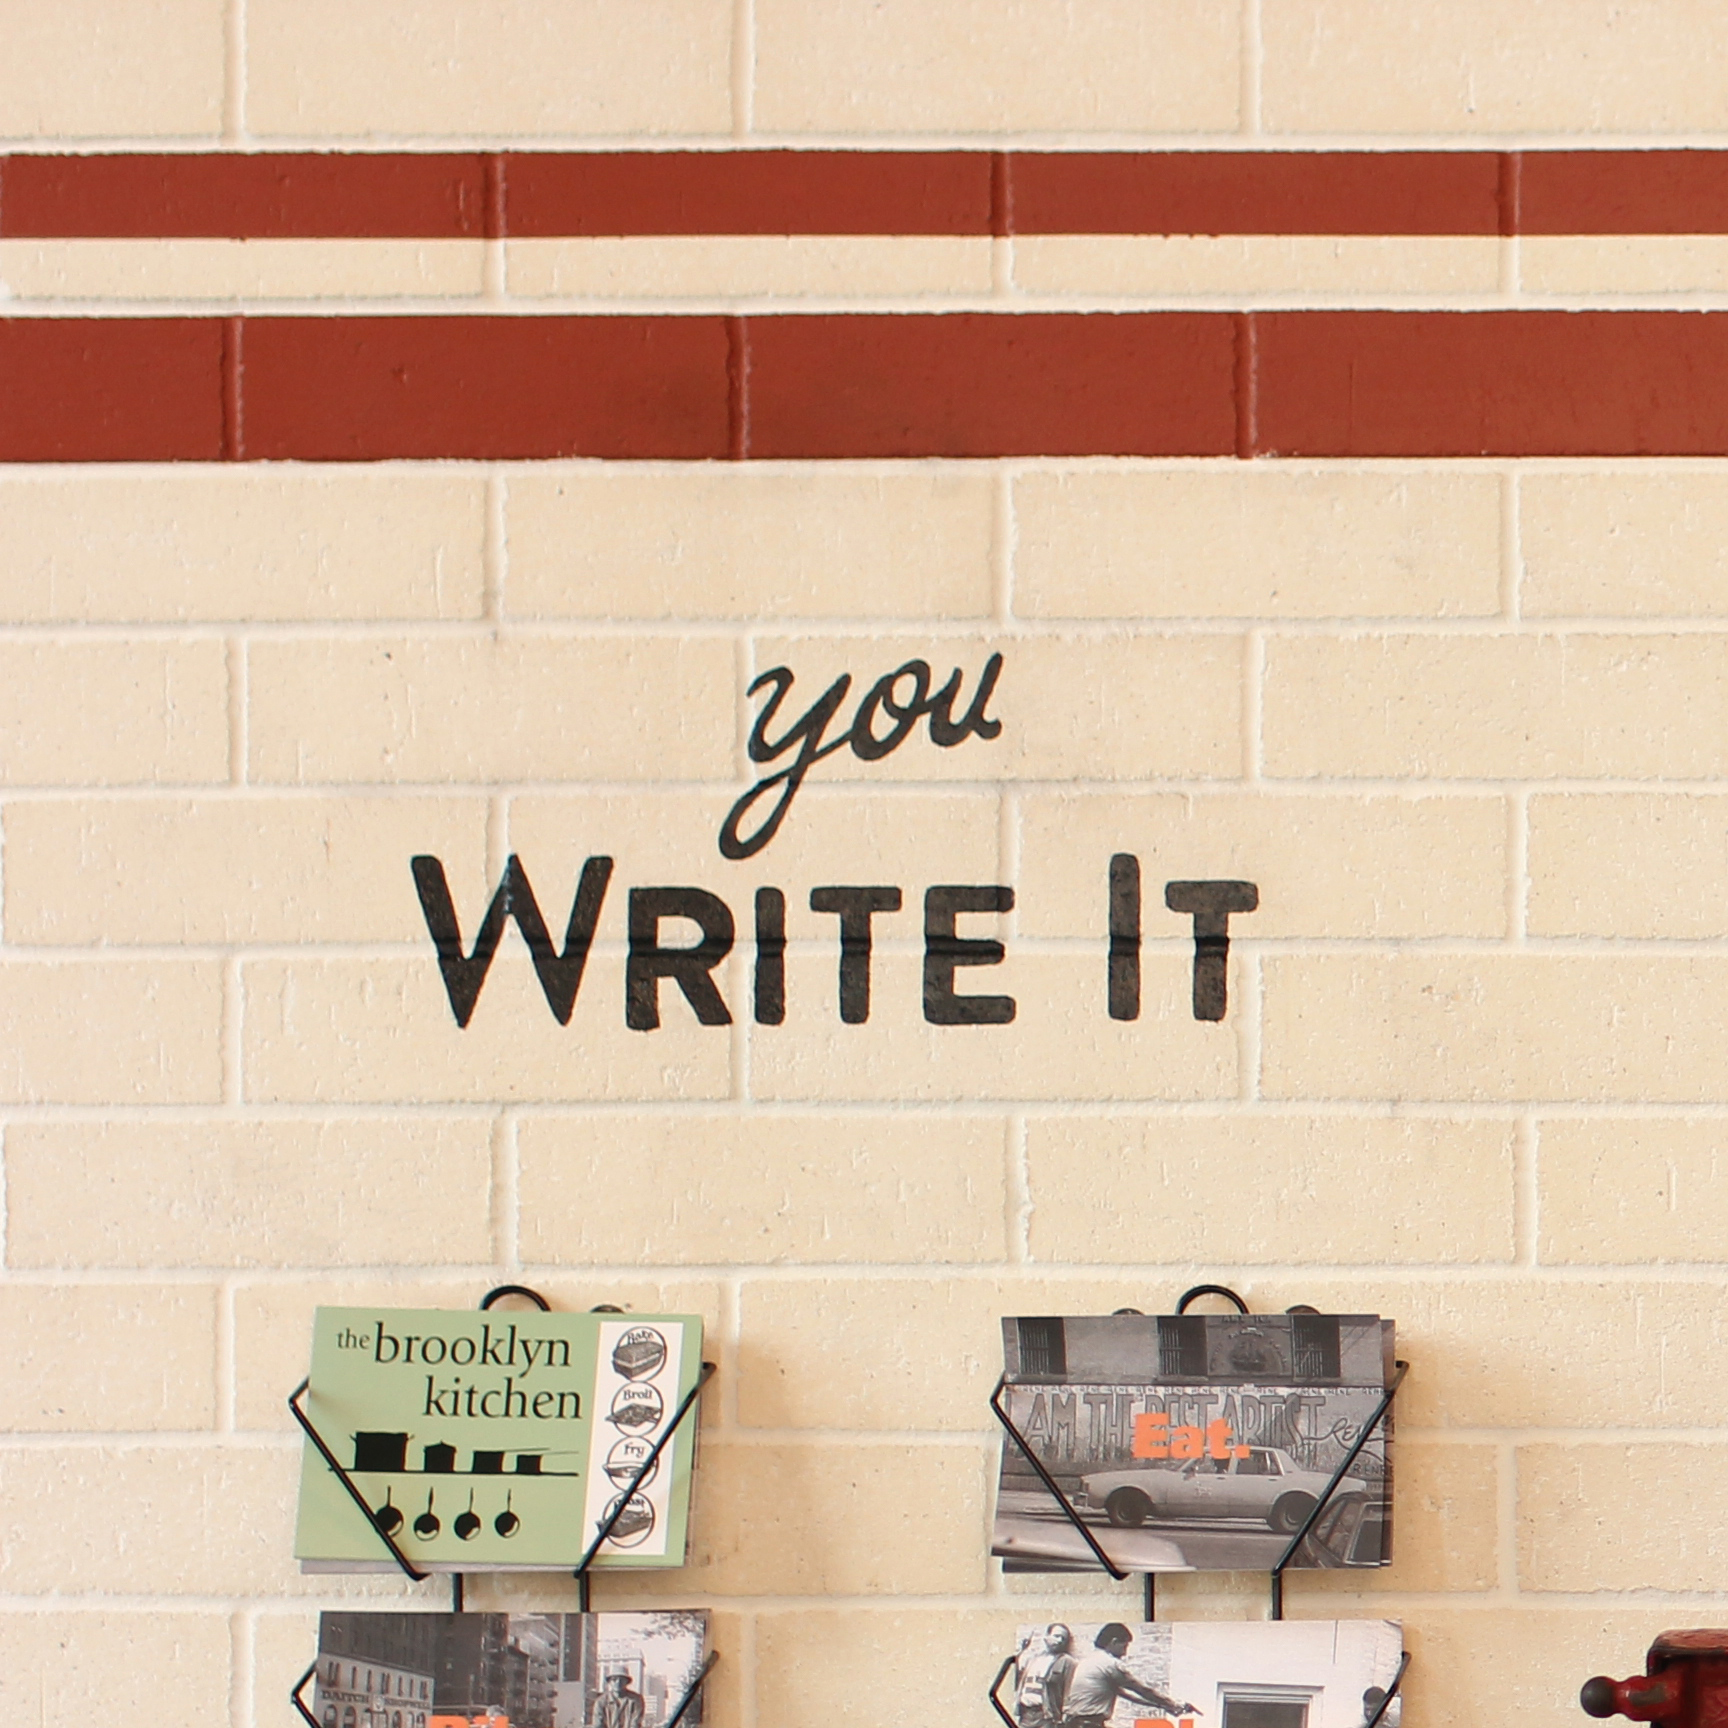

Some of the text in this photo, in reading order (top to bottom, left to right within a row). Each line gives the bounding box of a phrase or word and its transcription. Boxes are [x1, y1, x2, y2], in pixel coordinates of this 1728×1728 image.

[718, 653, 1003, 859] you
[410, 852, 1259, 1031] WRITE IT
[336, 1321, 572, 1377] the brooklyn
[421, 1375, 582, 1419] kitchen
[623, 1389, 652, 1400] Broil
[623, 1441, 645, 1458] Fry
[1132, 1412, 1250, 1460] Eat.
